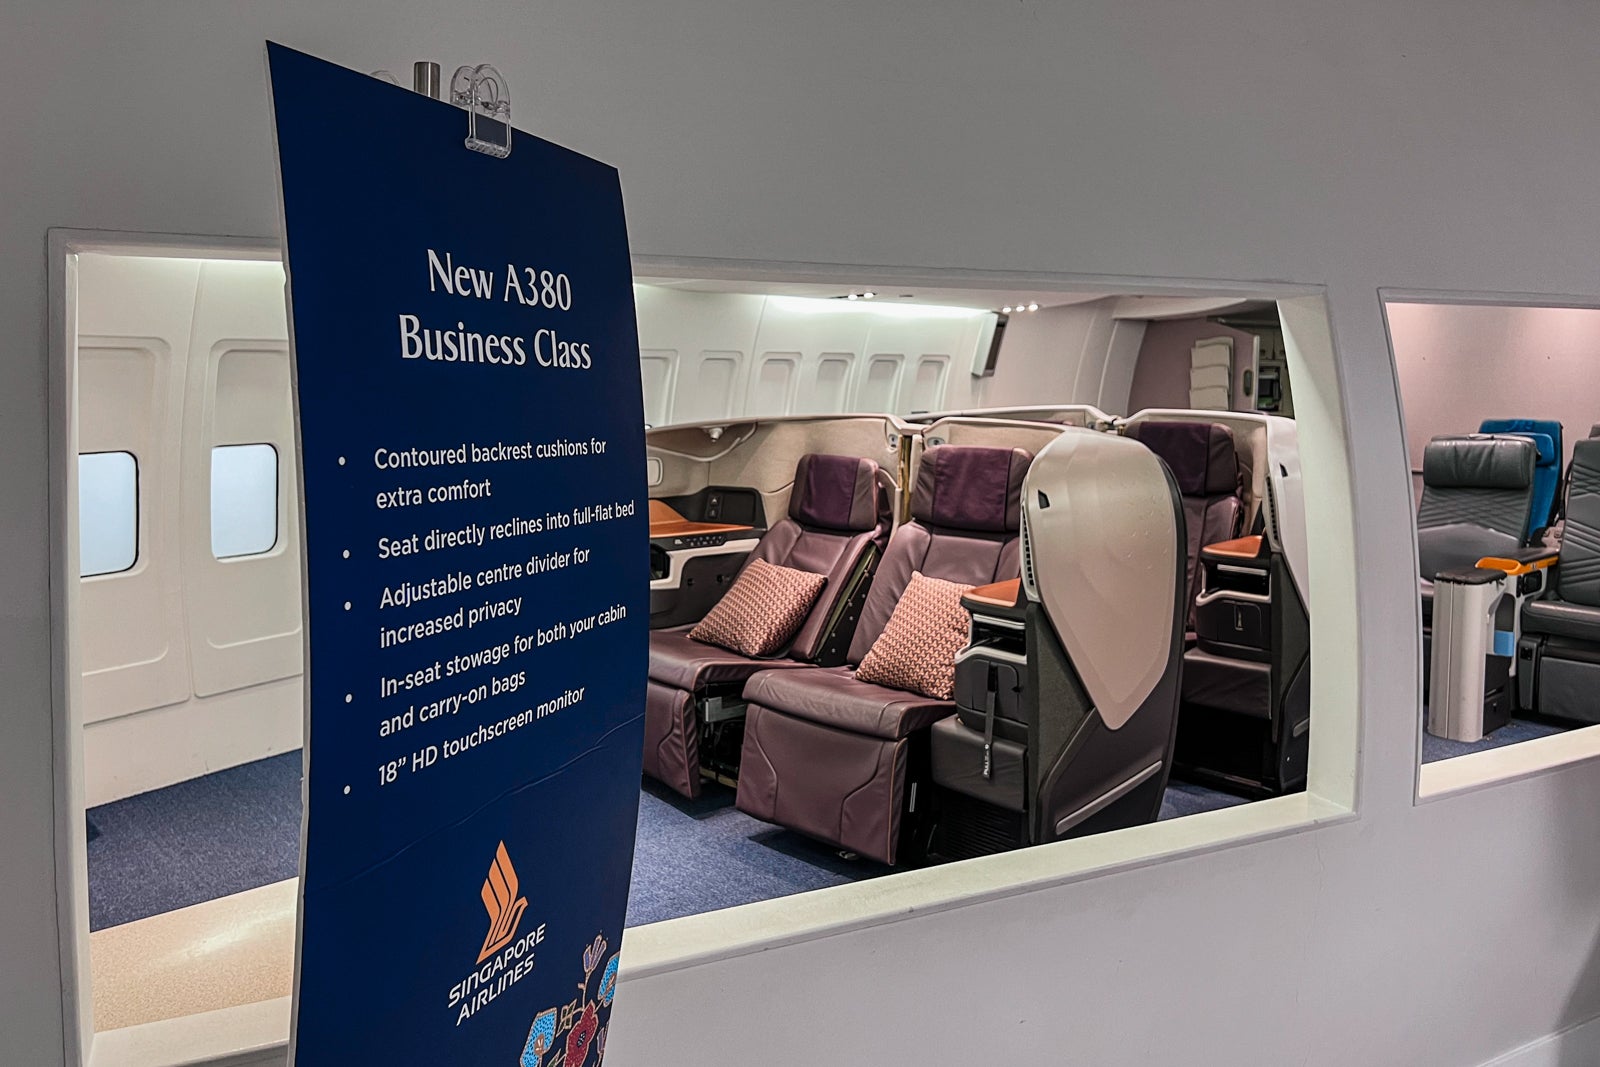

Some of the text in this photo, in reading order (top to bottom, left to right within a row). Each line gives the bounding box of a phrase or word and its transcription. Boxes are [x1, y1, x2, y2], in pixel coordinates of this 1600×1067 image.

[427, 248, 572, 311] New A380
[399, 314, 592, 370] Business Class
[374, 437, 607, 470] Contoured backrest cushions for
[376, 478, 492, 509] extra comfort
[378, 499, 635, 560] Seat directly reclines into full-flat bed
[379, 547, 591, 610] Adjustable centre divider for
[380, 596, 523, 650] increased privacy
[380, 604, 627, 699] In-seat stowage for both your cabin
[378, 670, 526, 738] and carry-on bags
[411, 746, 438, 774] HD
[442, 709, 534, 761] touchscreen
[535, 687, 586, 721] monitor
[447, 922, 547, 1009] SINGAPORE
[456, 953, 535, 1027] AIRLINES
